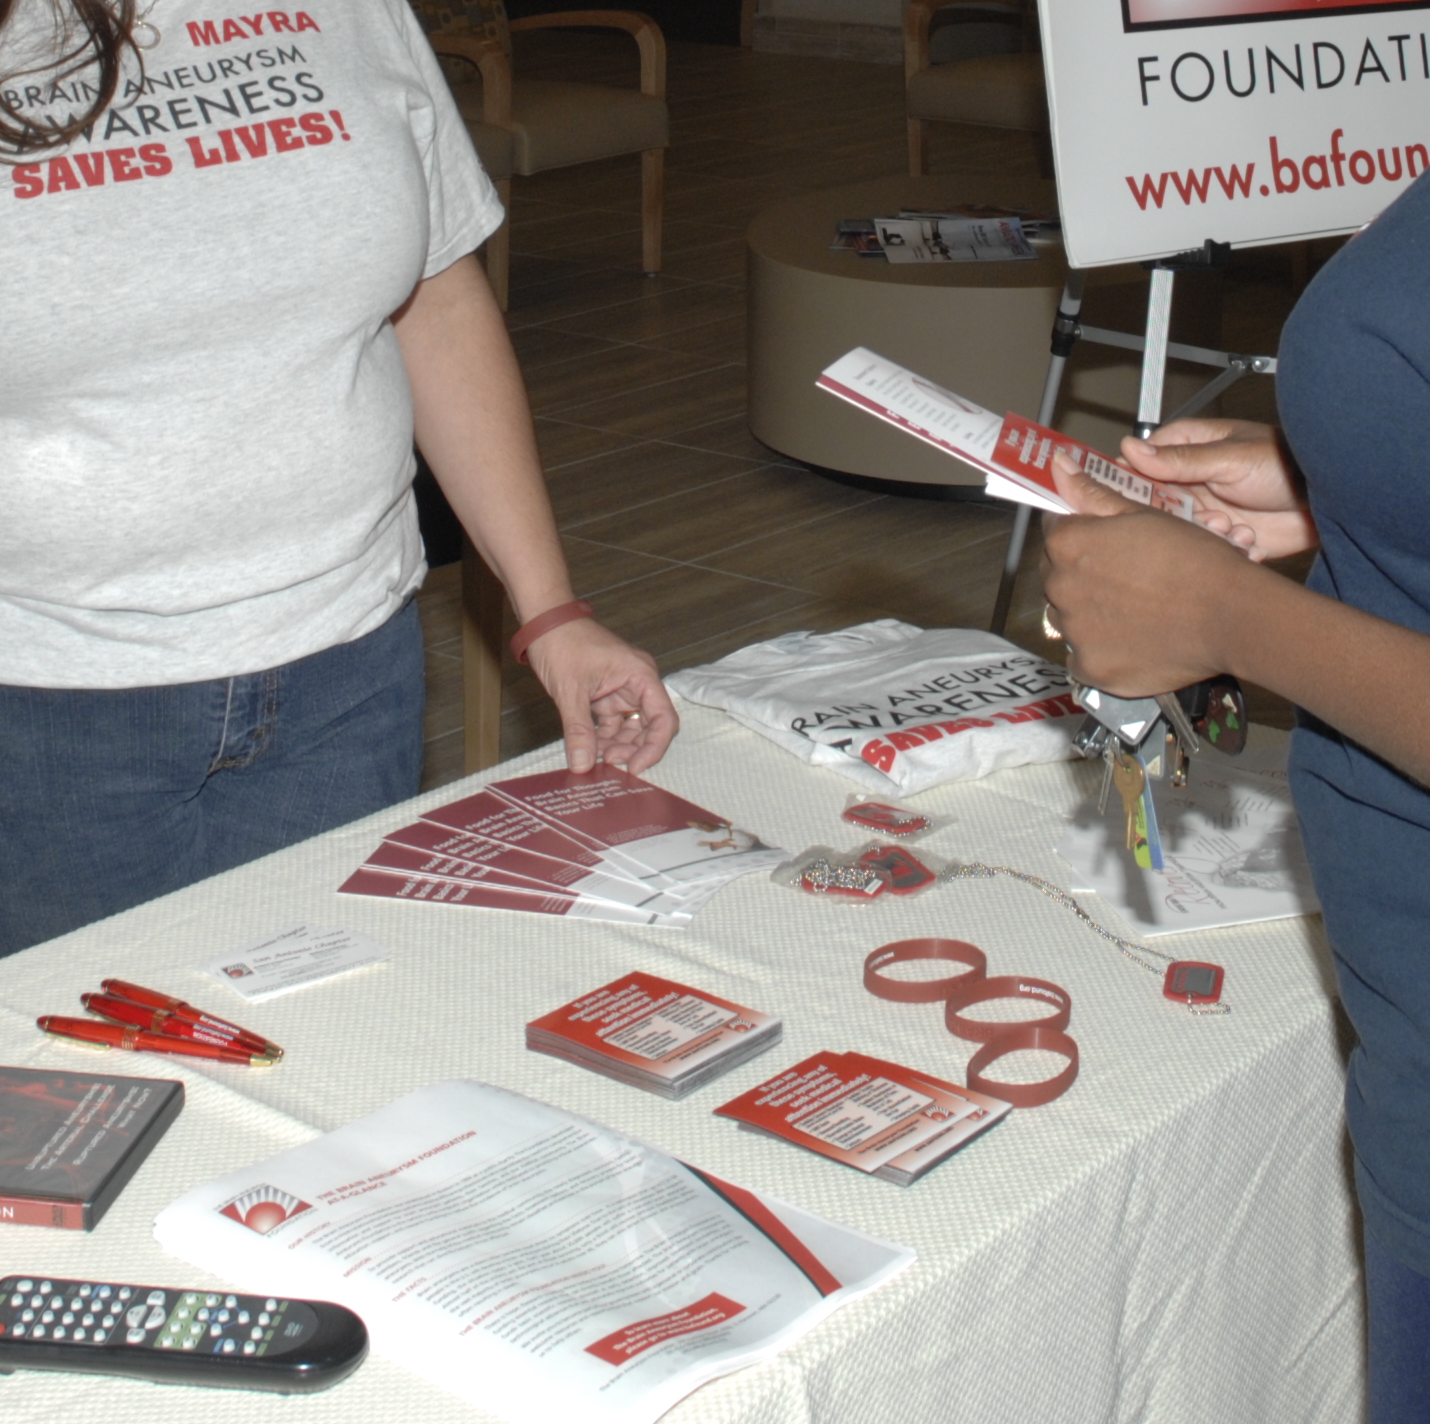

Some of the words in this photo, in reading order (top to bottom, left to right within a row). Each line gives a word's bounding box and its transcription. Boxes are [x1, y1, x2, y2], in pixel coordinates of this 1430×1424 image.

[185, 11, 321, 47] MAYRA
[123, 43, 308, 98] ANEURYSM
[11, 142, 173, 199] SAVES
[185, 109, 352, 169] LIVES!
[790, 702, 880, 738] RAIN
[887, 656, 1051, 708] ANEURYS
[861, 717, 995, 774] SAVES
[316, 1189, 335, 1200] THE
[335, 1179, 367, 1193] BRAIN
[367, 1159, 419, 1183] ANEURYSM
[418, 1129, 477, 1161] FOUNDATION
